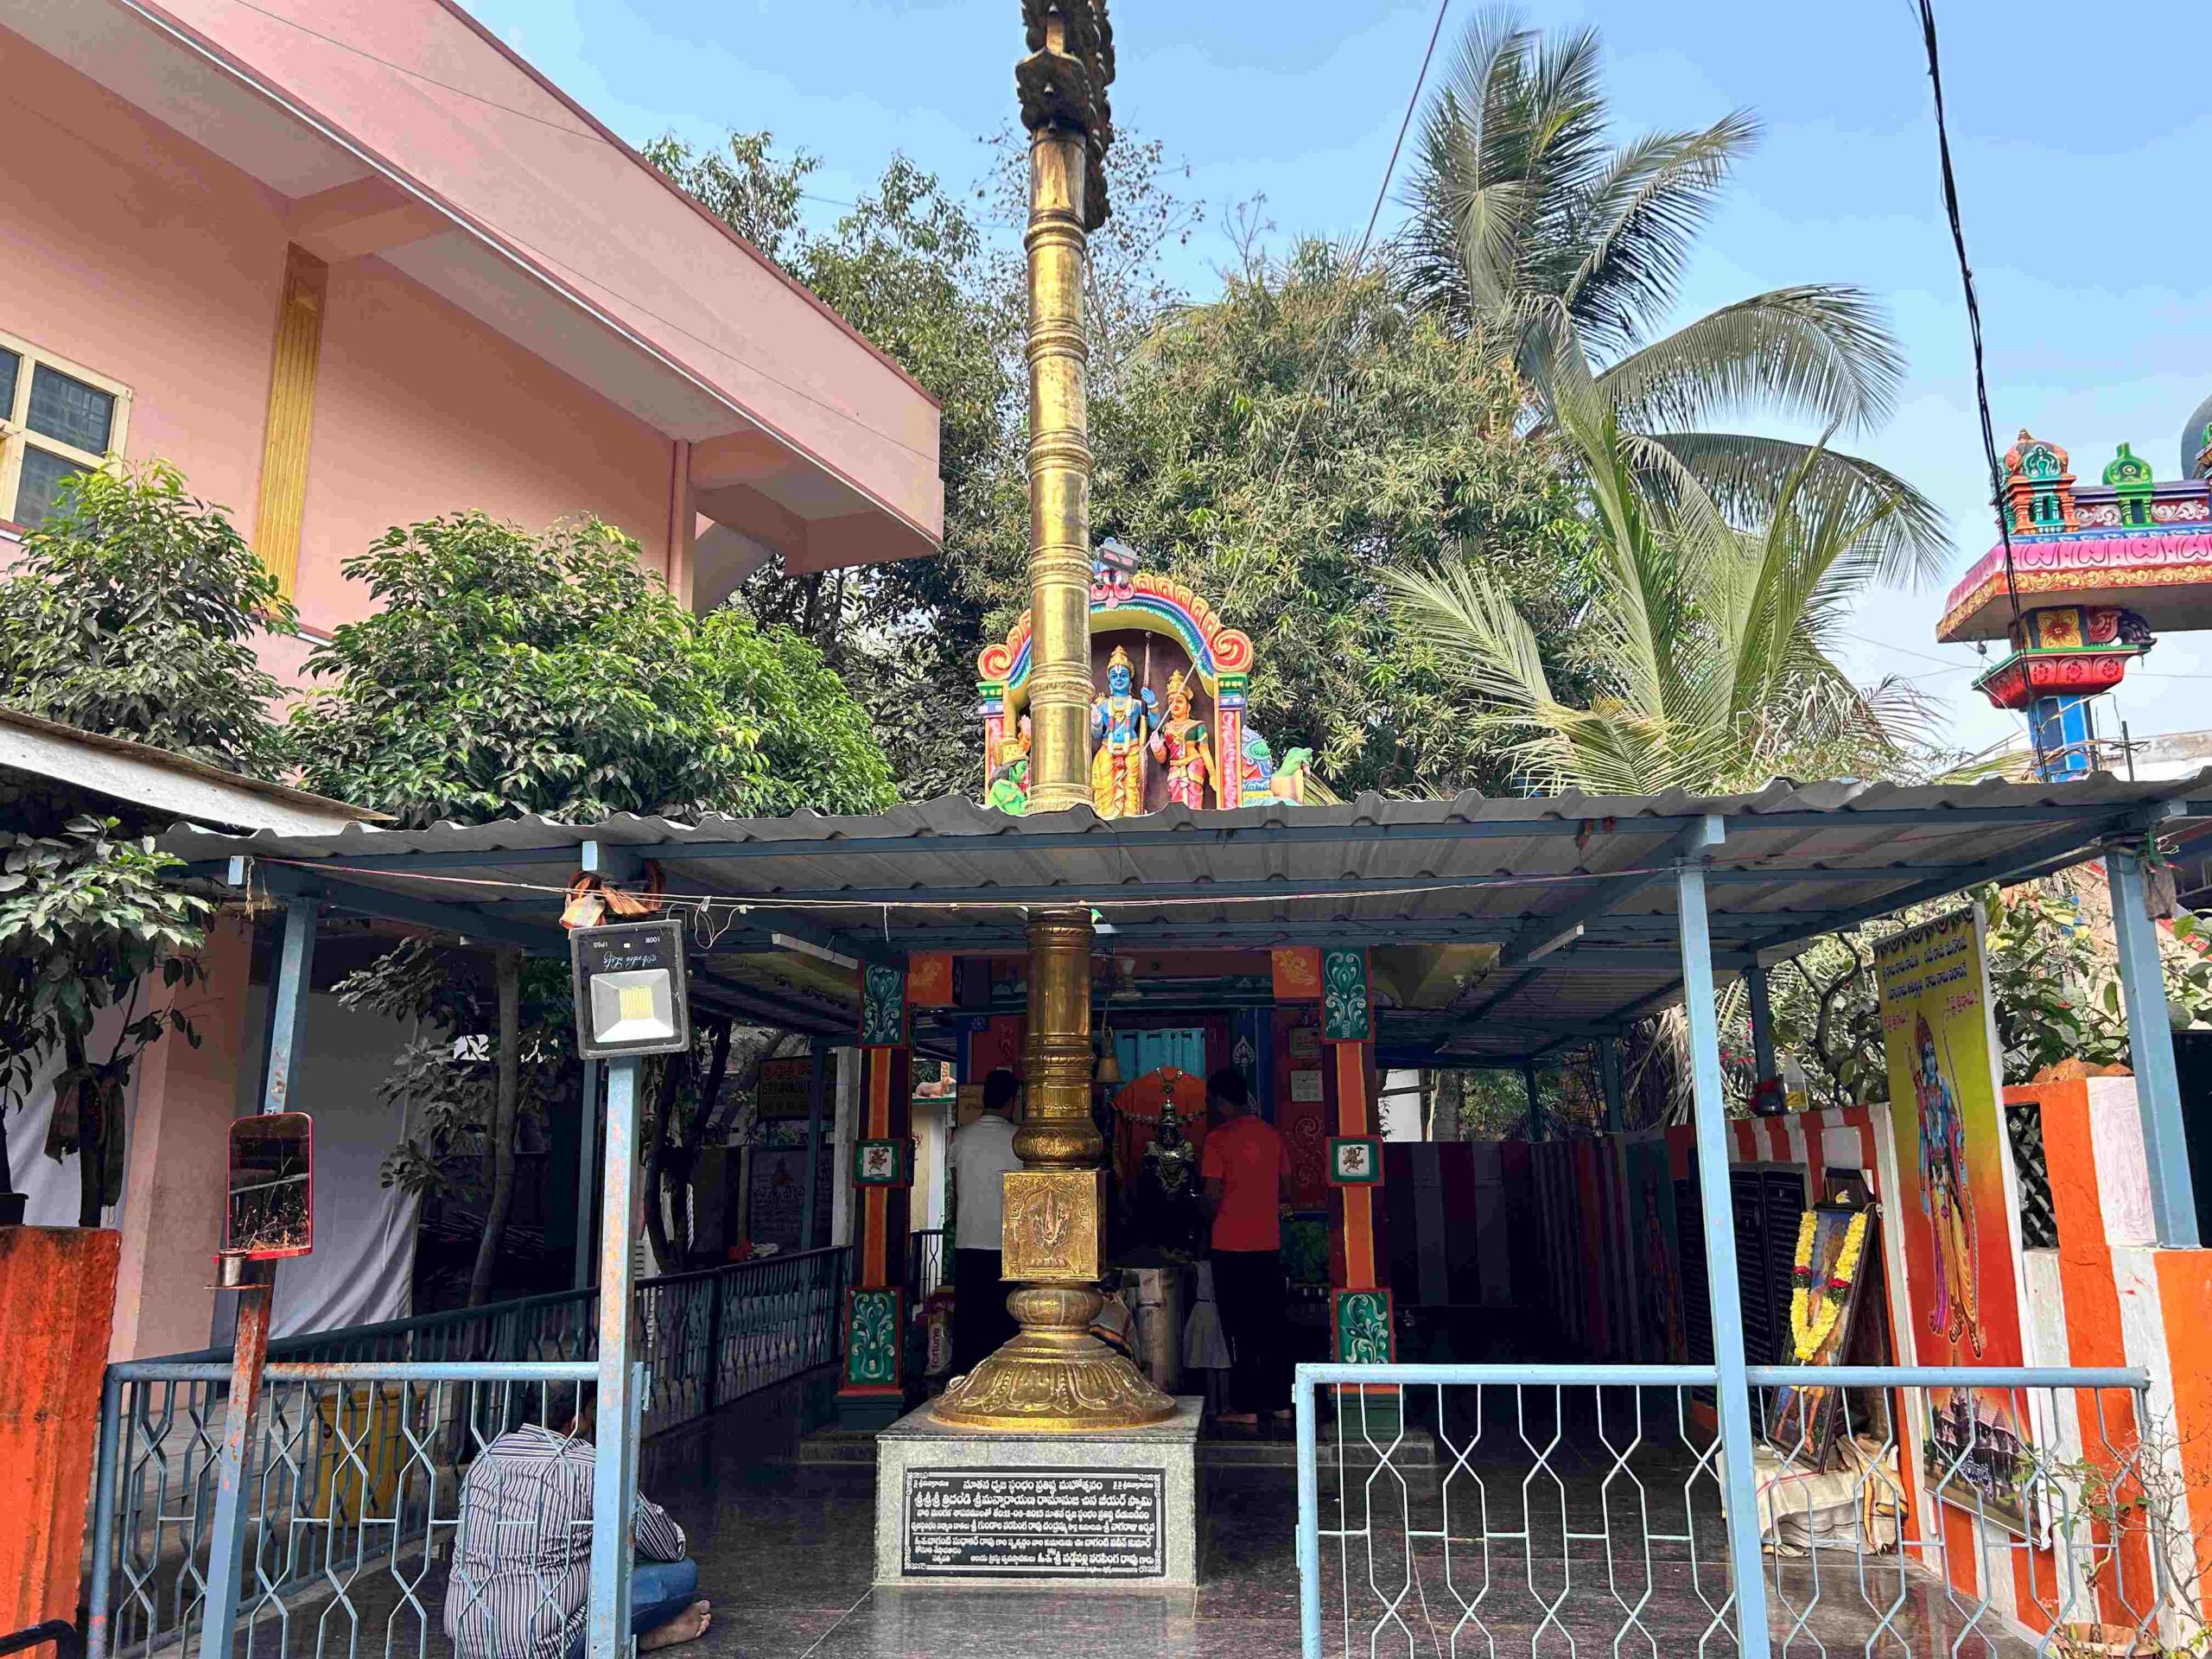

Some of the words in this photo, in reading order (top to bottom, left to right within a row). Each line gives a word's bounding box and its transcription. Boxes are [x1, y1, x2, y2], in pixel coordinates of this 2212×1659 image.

[931, 1327, 940, 1369] fortune
[963, 1479, 989, 1490] నూతన
[991, 1479, 1007, 1493] ధ్వజ
[1058, 1478, 1103, 1493] మహోత్సవం
[942, 1492, 971, 1508] త్రిదండి
[973, 1492, 1035, 1509] శ్రీమన్నారాయణ
[1037, 1495, 1079, 1505] రామానుజ
[1081, 1496, 1096, 1505] చిన
[1098, 1494, 1127, 1506] జీయర్
[1128, 1495, 1153, 1510] స్వామి
[1028, 1521, 1042, 1532] రావు
[980, 1536, 995, 1547] రావు
[1120, 1554, 1138, 1566] రావు
